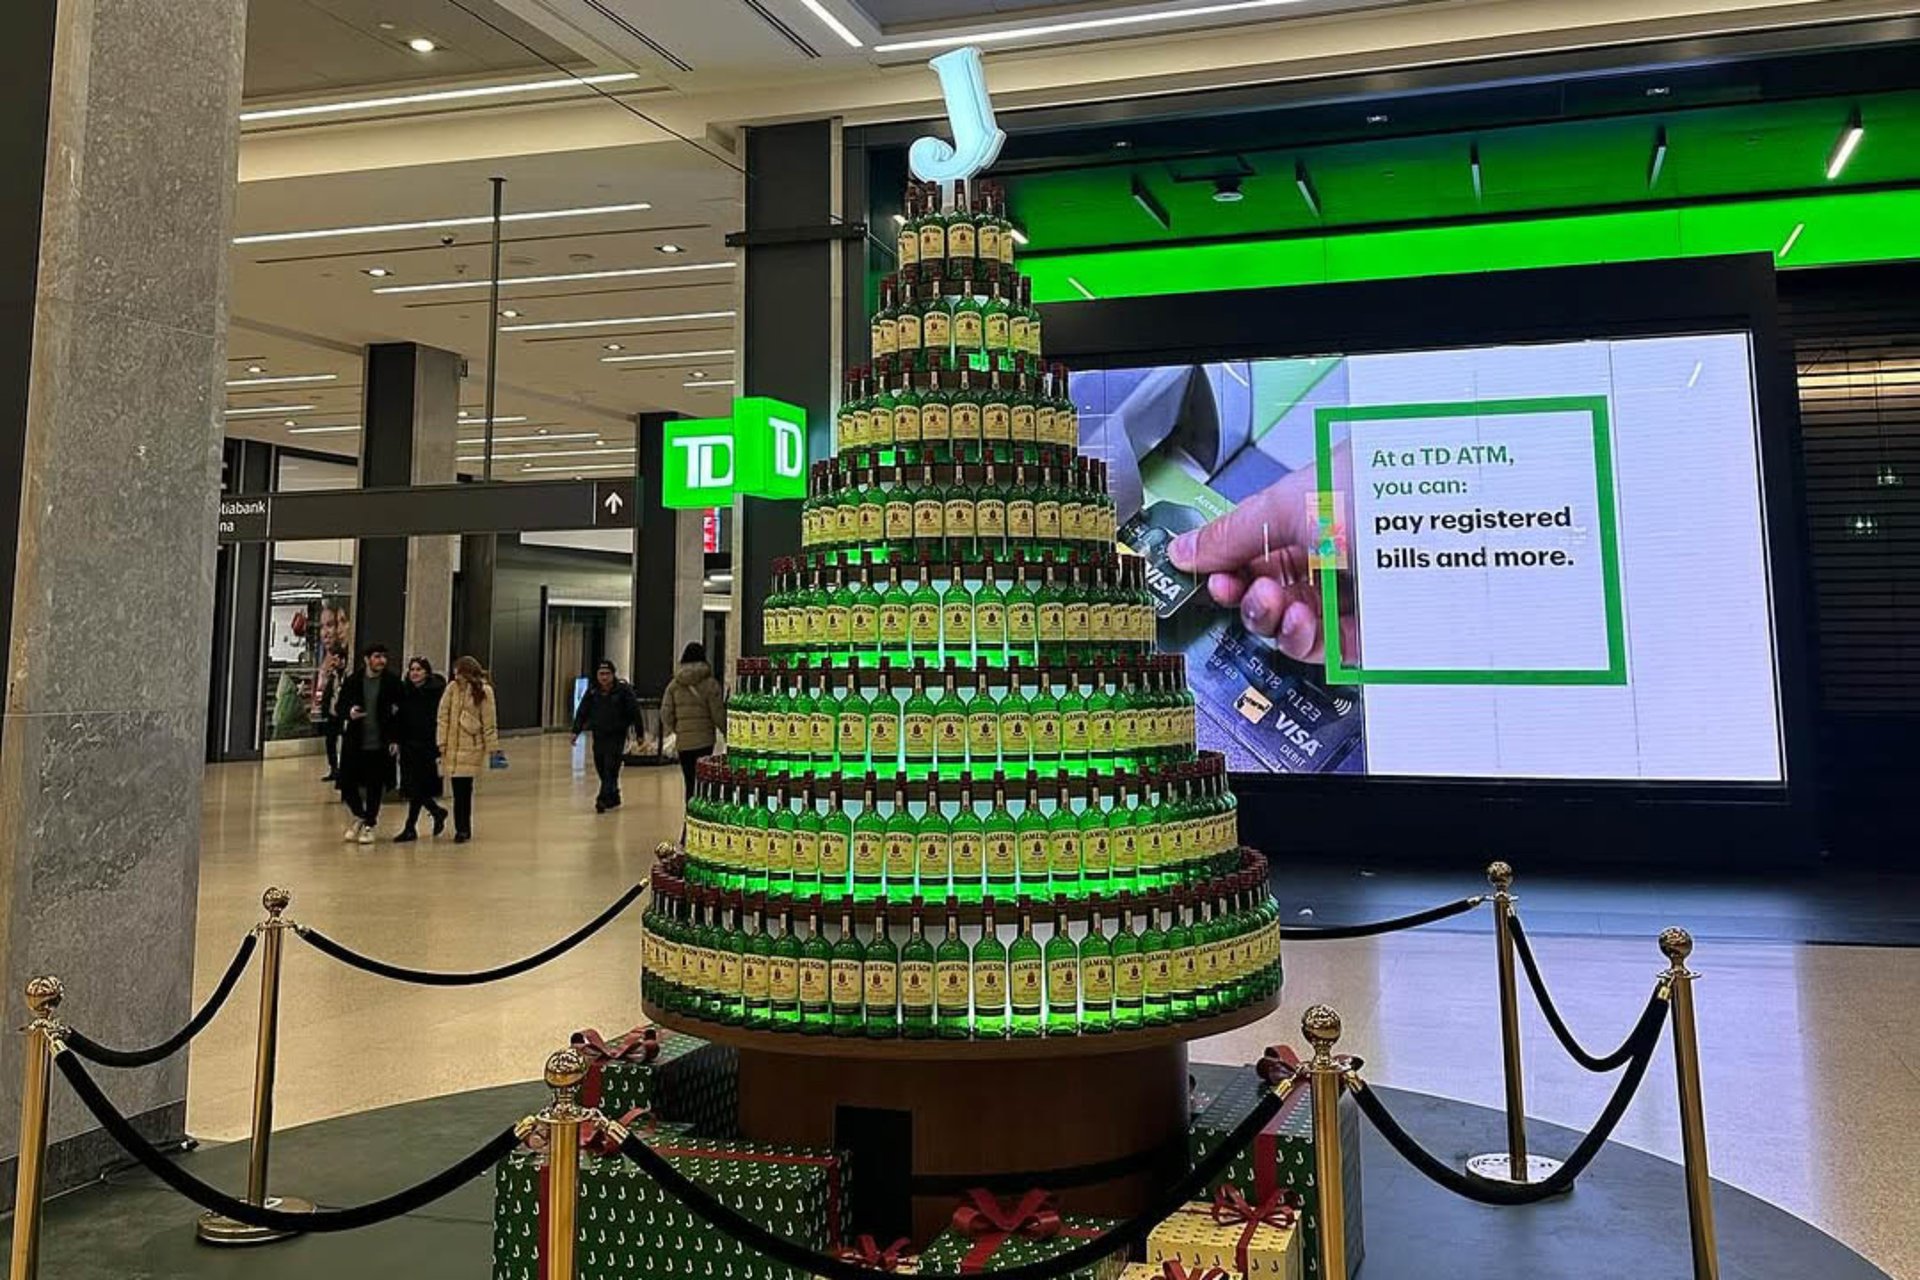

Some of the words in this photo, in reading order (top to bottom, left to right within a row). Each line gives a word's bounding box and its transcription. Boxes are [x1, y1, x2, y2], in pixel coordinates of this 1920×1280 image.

[909, 46, 1007, 184] J
[768, 417, 803, 478] TD
[1372, 450, 1397, 468] At
[1401, 453, 1415, 467] a
[1420, 447, 1450, 466] TD
[1457, 446, 1515, 467] ATM,
[672, 435, 733, 489] TD
[1374, 481, 1413, 500] you
[1419, 479, 1468, 496] can:
[219, 501, 266, 515] tiabank
[1375, 514, 1424, 535] pay
[1430, 506, 1572, 534] registered
[219, 521, 234, 533] na
[1377, 547, 1431, 569] bills
[1436, 547, 1488, 568] and
[1494, 549, 1575, 567] more.
[1275, 710, 1321, 757] VISA
